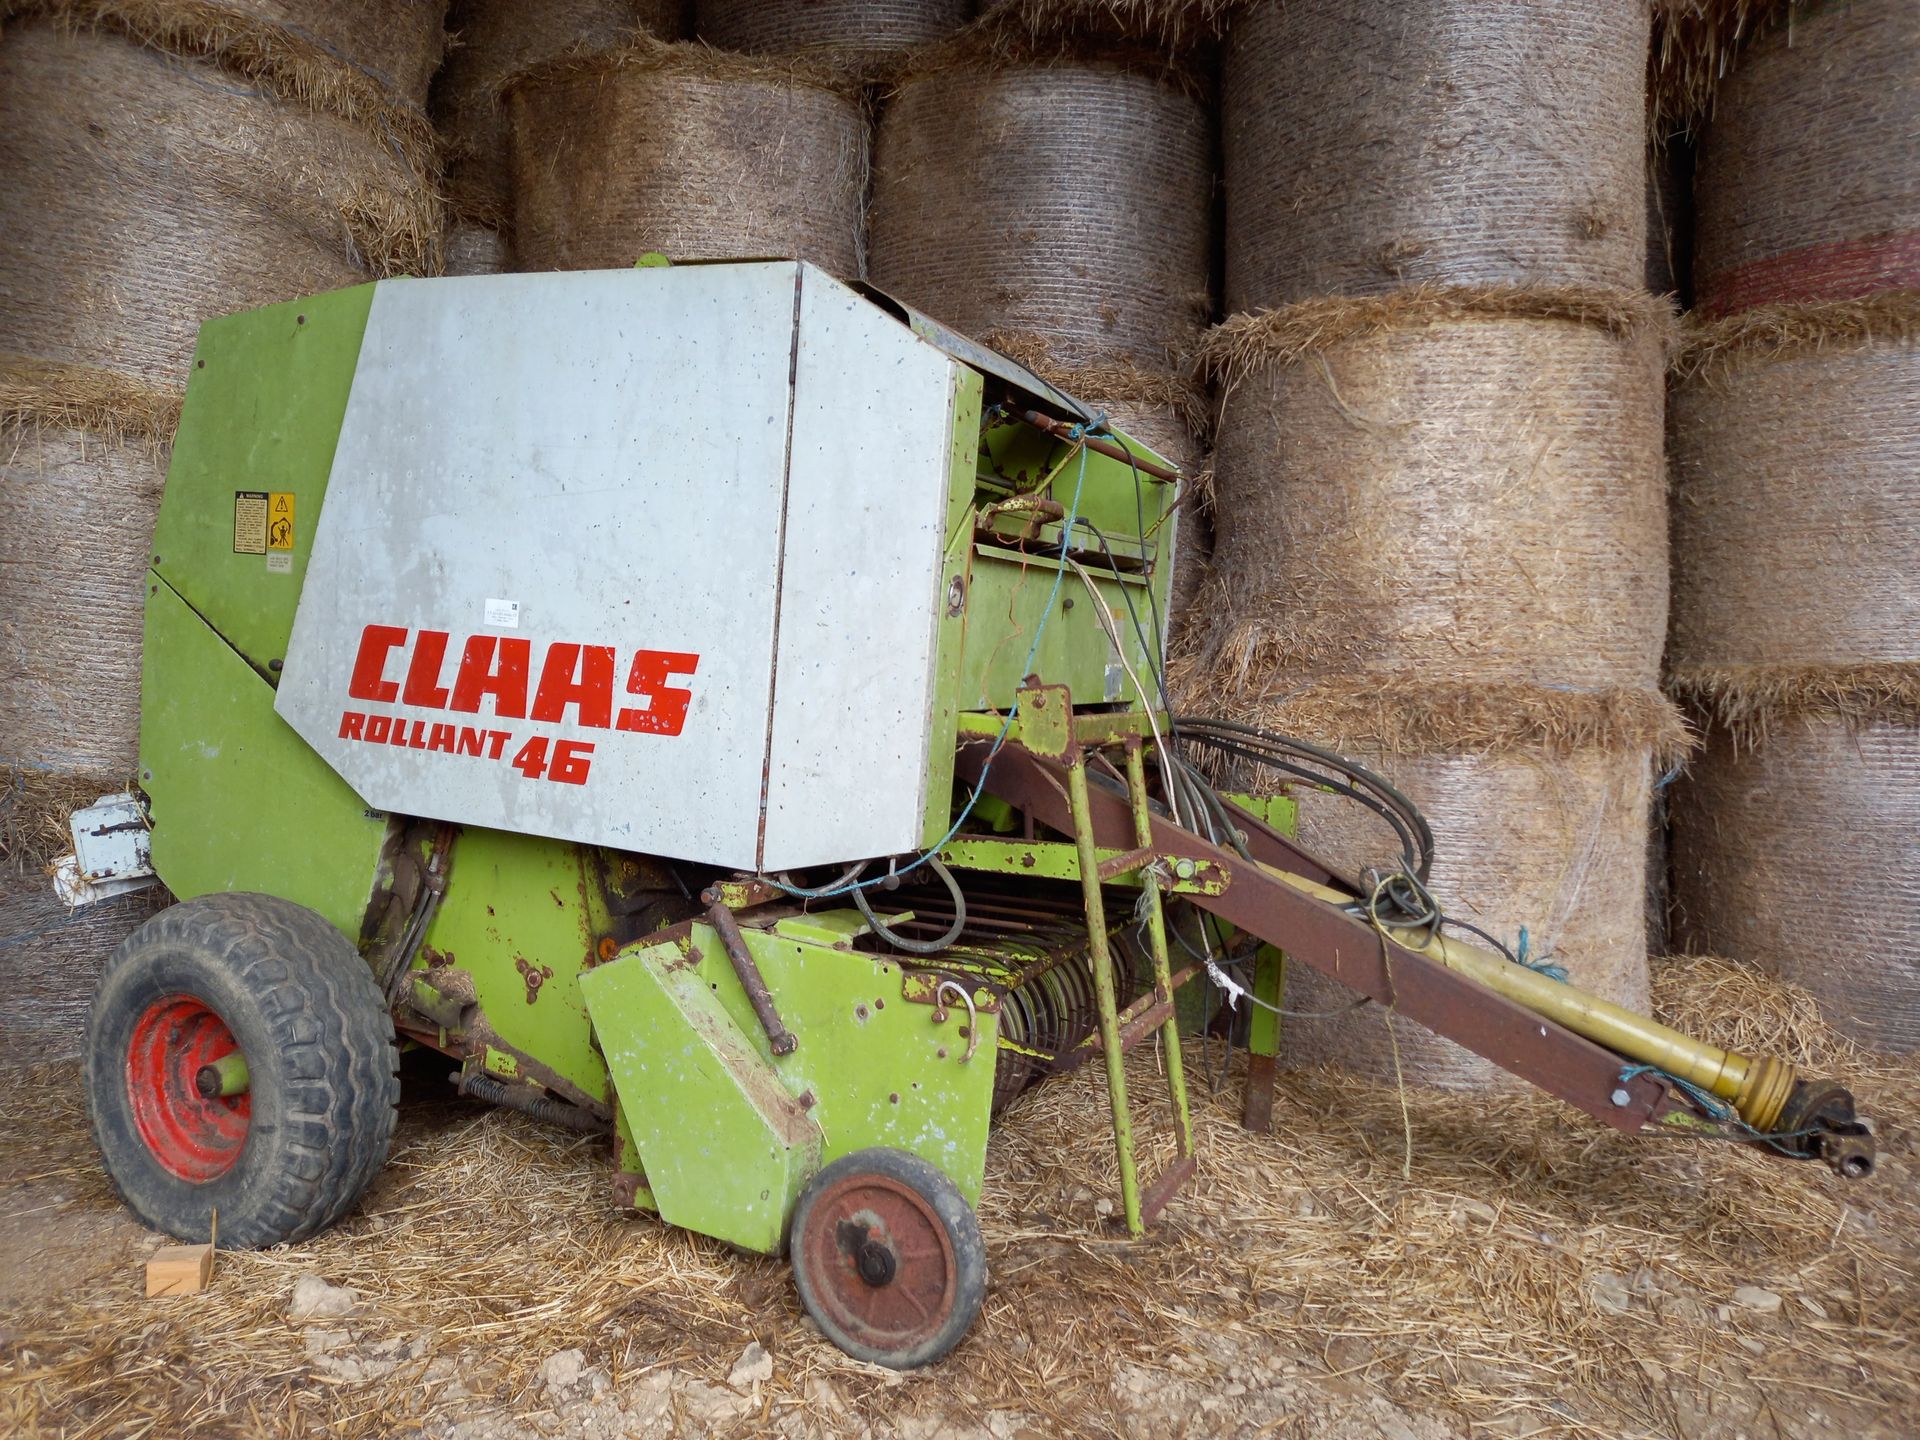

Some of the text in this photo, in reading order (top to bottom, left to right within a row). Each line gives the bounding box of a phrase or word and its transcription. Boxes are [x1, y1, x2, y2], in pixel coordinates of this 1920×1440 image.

[348, 624, 700, 737] CLAAS
[338, 711, 596, 786] ROLLANT 46
